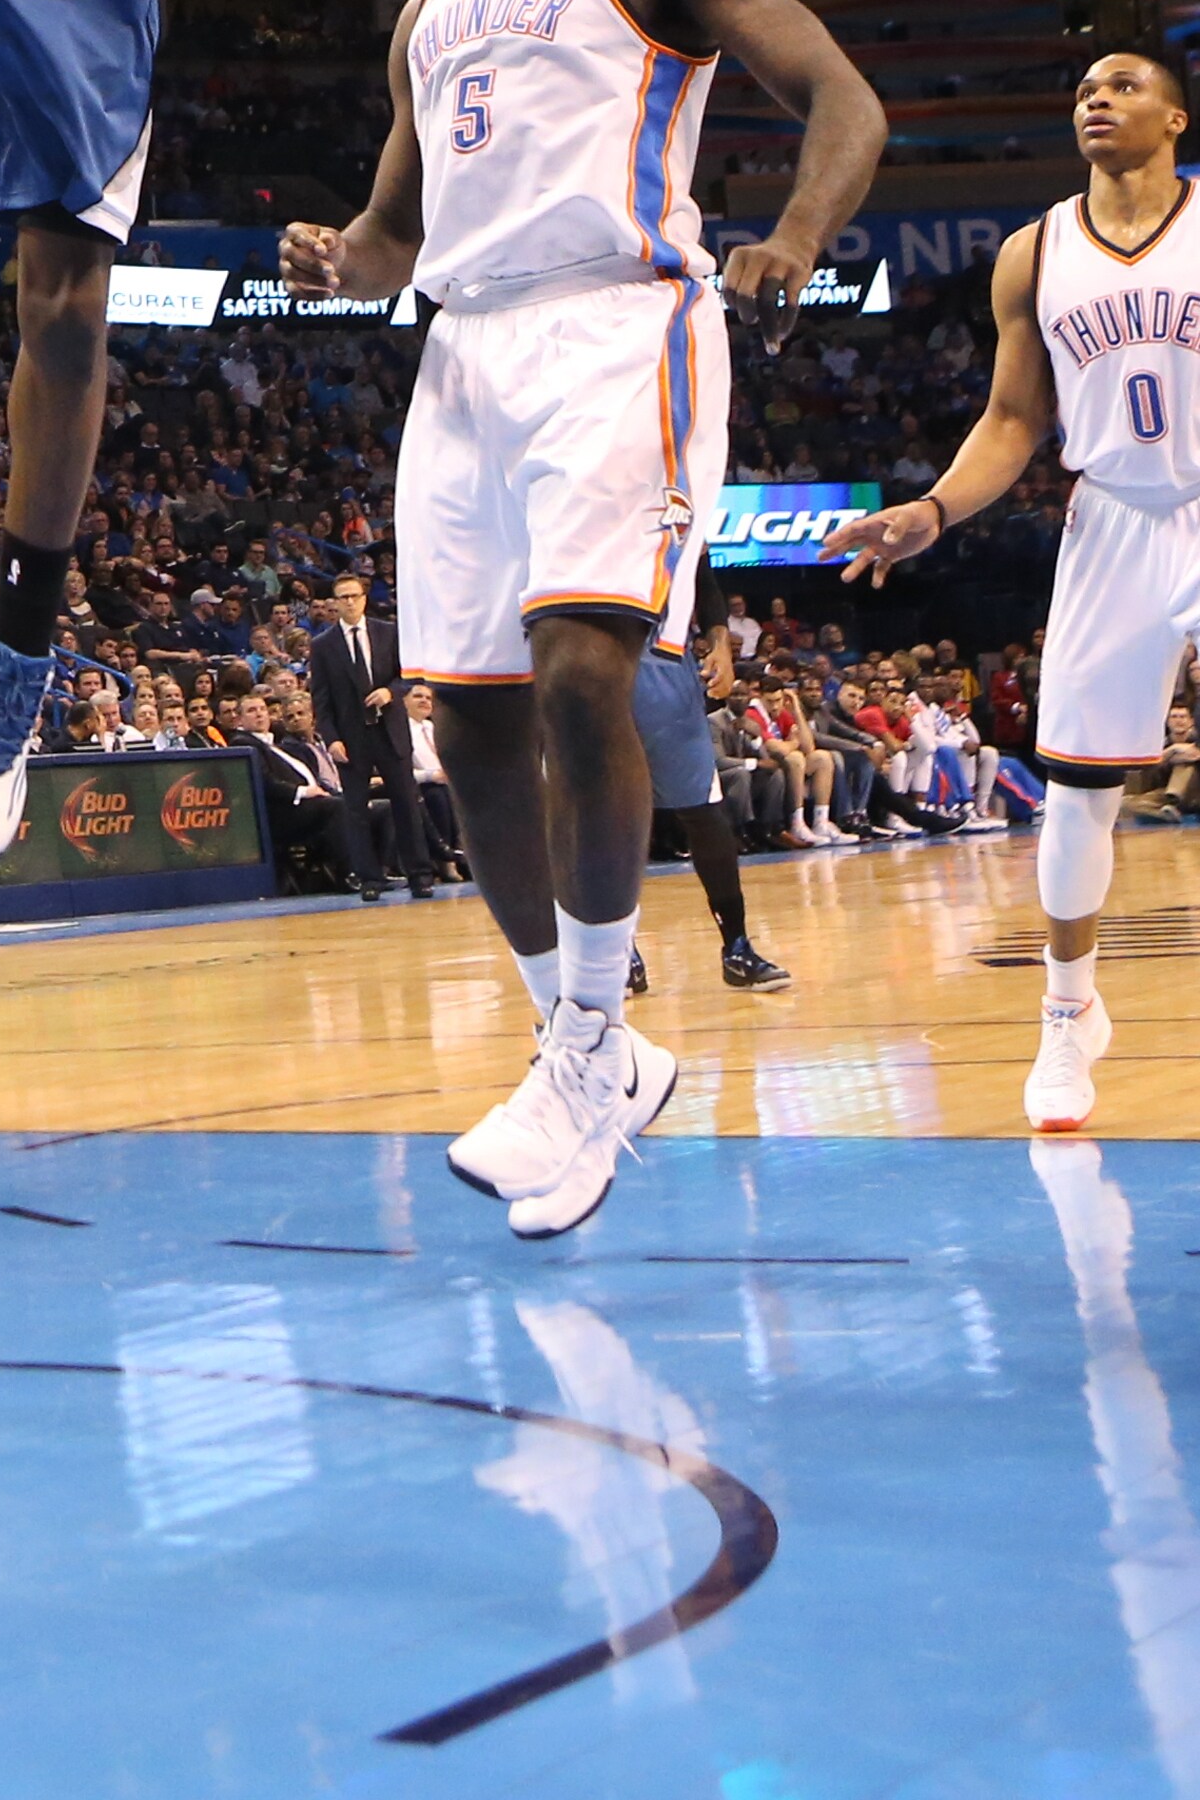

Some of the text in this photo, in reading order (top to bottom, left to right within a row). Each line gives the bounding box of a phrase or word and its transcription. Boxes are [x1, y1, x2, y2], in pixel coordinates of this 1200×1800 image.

[451, 69, 497, 154] 5
[243, 280, 288, 298] FULL
[223, 298, 291, 317] SAFETY
[1123, 369, 1168, 443] 0
[704, 508, 868, 544] LIGHT
[81, 791, 127, 814] BUD
[180, 786, 222, 808] BUD
[74, 814, 135, 836] LIGHT
[174, 808, 230, 830] LIGHT
